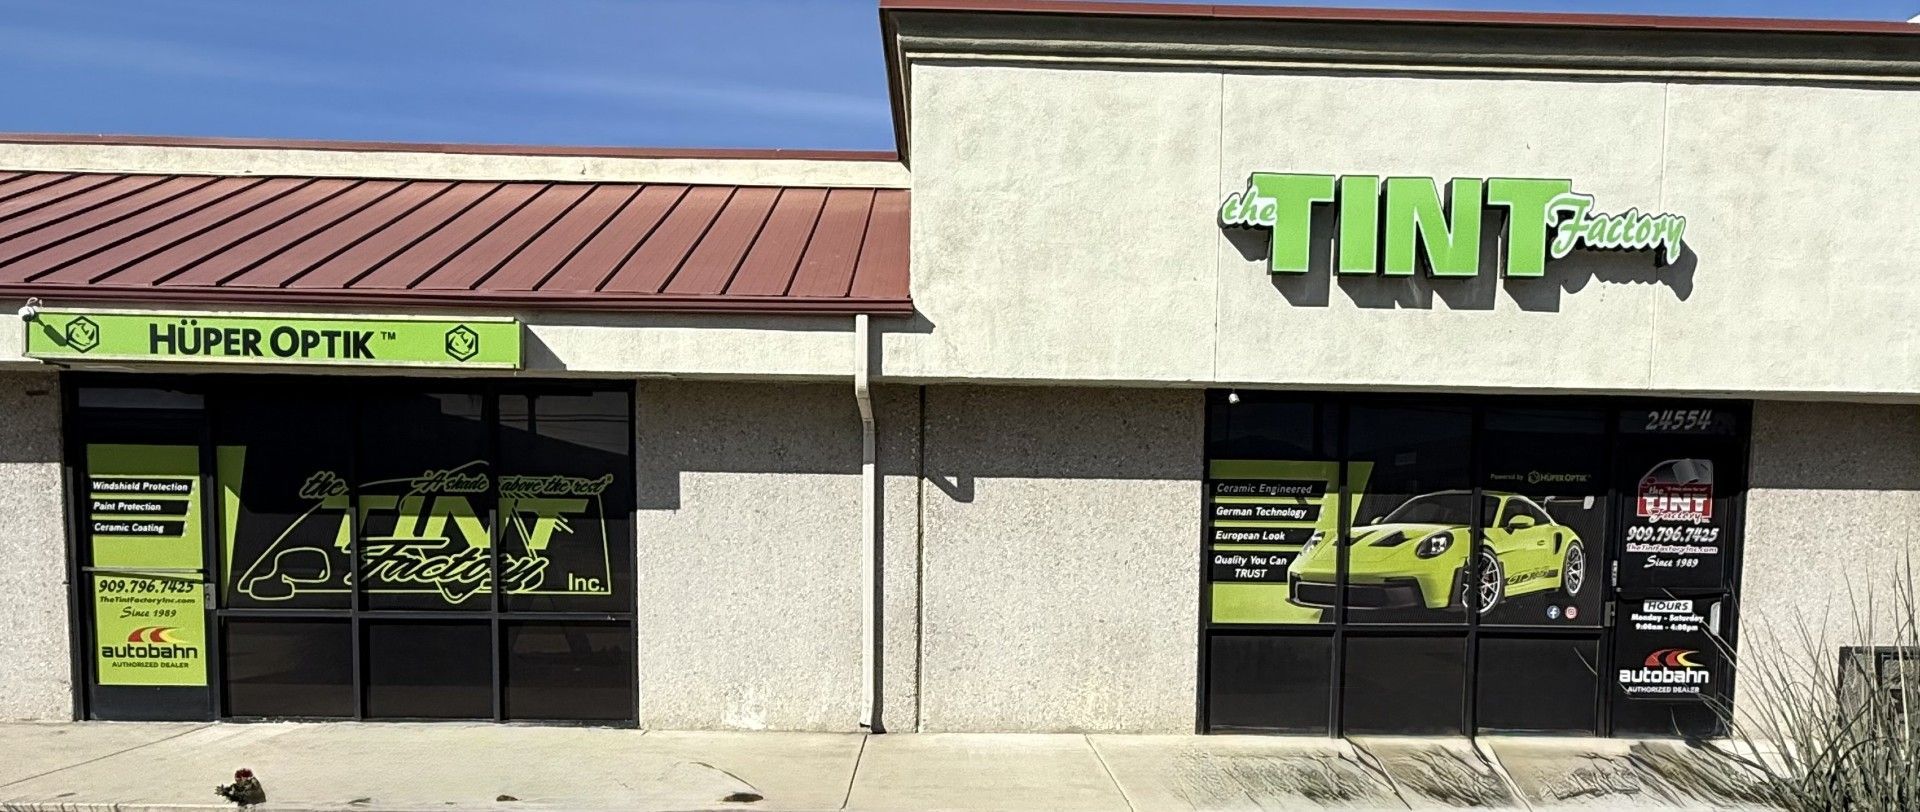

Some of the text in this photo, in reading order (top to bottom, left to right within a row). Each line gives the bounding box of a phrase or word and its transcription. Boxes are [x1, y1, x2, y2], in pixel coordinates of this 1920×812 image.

[1222, 188, 1276, 224] the
[1251, 173, 1572, 276] TINT
[1546, 195, 1686, 262] Factory
[150, 319, 263, 356] HÜPER
[270, 325, 375, 359] OPTIK
[1645, 409, 1712, 430] 24554
[92, 481, 188, 491] Windshield Protection
[299, 471, 349, 499] the
[446, 473, 490, 492] shade
[501, 475, 541, 493] above
[542, 475, 570, 494] the
[1217, 483, 1312, 495] Ceramic Engineered
[1648, 485, 1664, 495] the
[93, 501, 161, 511] Paint Protection
[1642, 493, 1708, 512] TINT
[1216, 506, 1307, 519] German Technology
[1648, 507, 1703, 525] Factory
[94, 523, 164, 534] Ceramic Coating
[322, 495, 589, 550] TINT
[1215, 531, 1285, 541] European Look
[1626, 526, 1720, 543] 909.796.7425
[1214, 555, 1287, 566] Quality You Can
[1643, 555, 1698, 568] Since 1989
[1235, 569, 1267, 578] TRUST
[99, 580, 194, 593] 909.796.7425
[568, 573, 605, 591] Inc.
[120, 606, 177, 618] Since 1989
[1647, 601, 1689, 611] HOURS
[1631, 613, 1662, 623] Monday
[1669, 614, 1704, 623] Saturday
[101, 644, 198, 659] autobahn
[1619, 667, 1709, 683] autobahn
